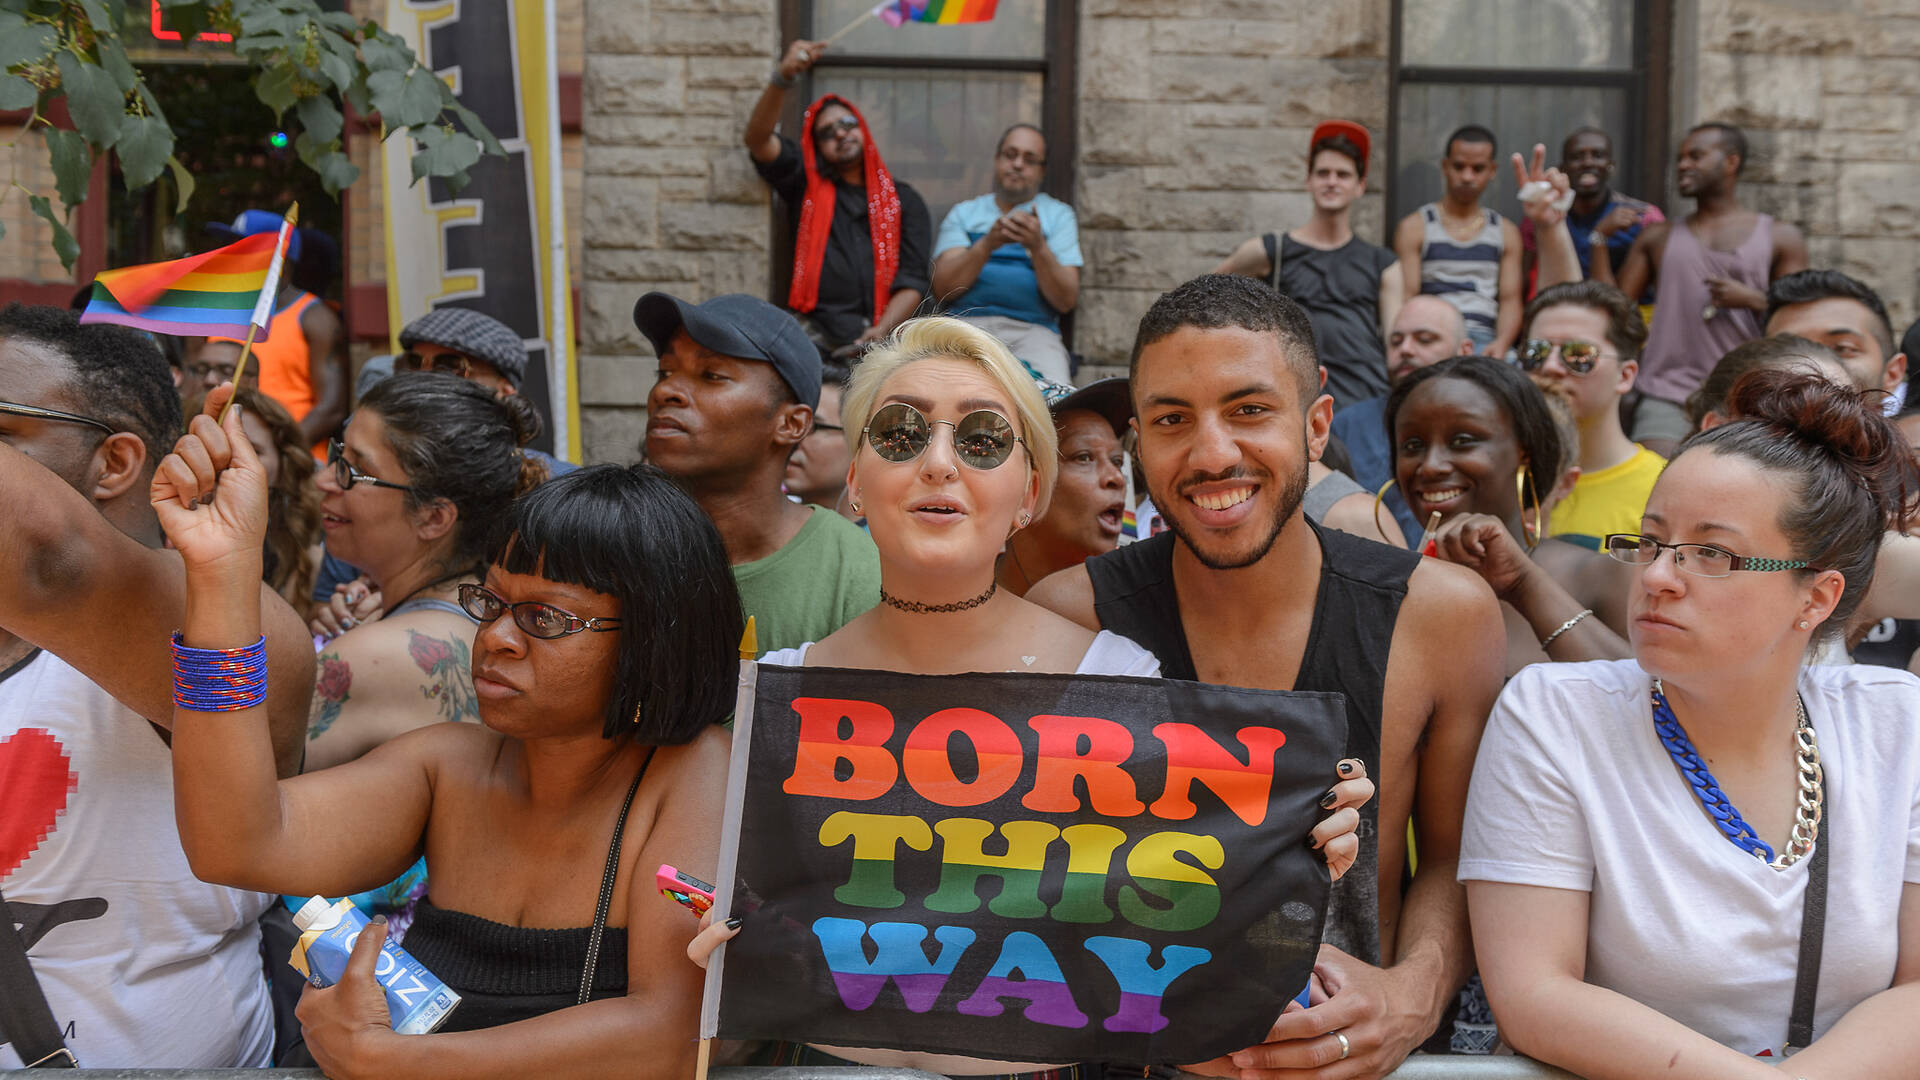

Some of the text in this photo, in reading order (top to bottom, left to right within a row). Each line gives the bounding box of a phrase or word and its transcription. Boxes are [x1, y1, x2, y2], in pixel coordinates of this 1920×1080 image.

[783, 697, 1286, 826] BORN
[818, 811, 1225, 931] THIS
[812, 916, 1212, 1034] WAY
